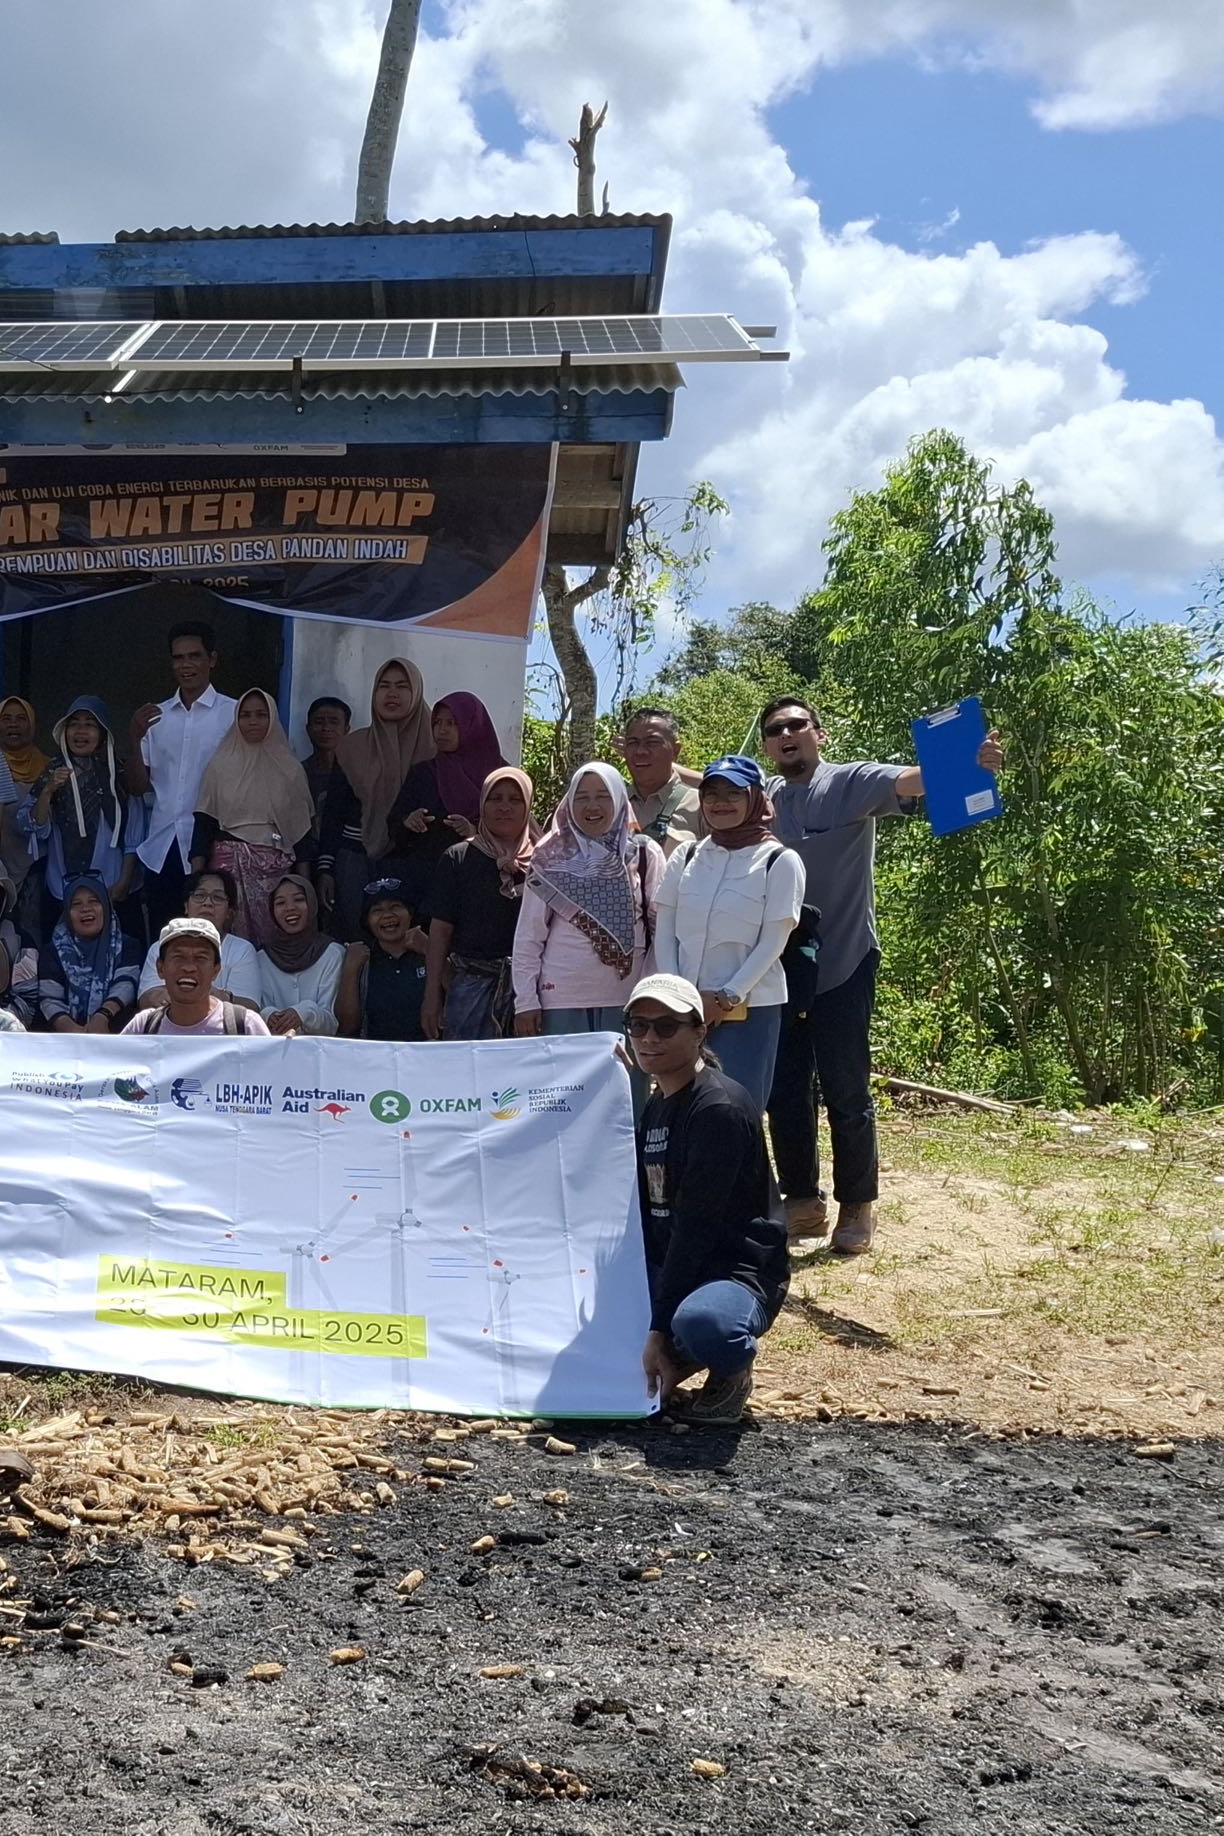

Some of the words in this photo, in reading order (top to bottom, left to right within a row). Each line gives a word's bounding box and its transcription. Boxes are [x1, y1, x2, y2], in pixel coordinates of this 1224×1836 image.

[22, 487, 48, 500] DAN
[52, 485, 75, 498] UJI
[79, 484, 113, 497] COBA
[117, 481, 164, 495] ENERGI
[168, 478, 256, 492] TERBARUKAN
[260, 476, 327, 487] BERBASIS
[331, 476, 389, 487] POTENSI
[393, 477, 429, 489] DESA
[89, 492, 255, 539] WATER
[282, 489, 435, 527] PUMP
[83, 550, 117, 570] DAN
[122, 543, 224, 569] DISABILITAS
[231, 540, 276, 562] DESA
[282, 538, 347, 559] PANDAN
[354, 538, 408, 559] INDAH
[10, 1083, 82, 1101] INDONESIA
[216, 1083, 273, 1105] LBH-APIK
[282, 1086, 365, 1102] Australian
[528, 1084, 584, 1094] KEMENTERIAN
[282, 1101, 309, 1113] Aid
[420, 1098, 482, 1113] OXFAM
[529, 1099, 567, 1107] REPUBLIK
[111, 1263, 273, 1305] MATARAM,
[231, 1312, 315, 1340] APRIL
[325, 1320, 404, 1345] 2025
